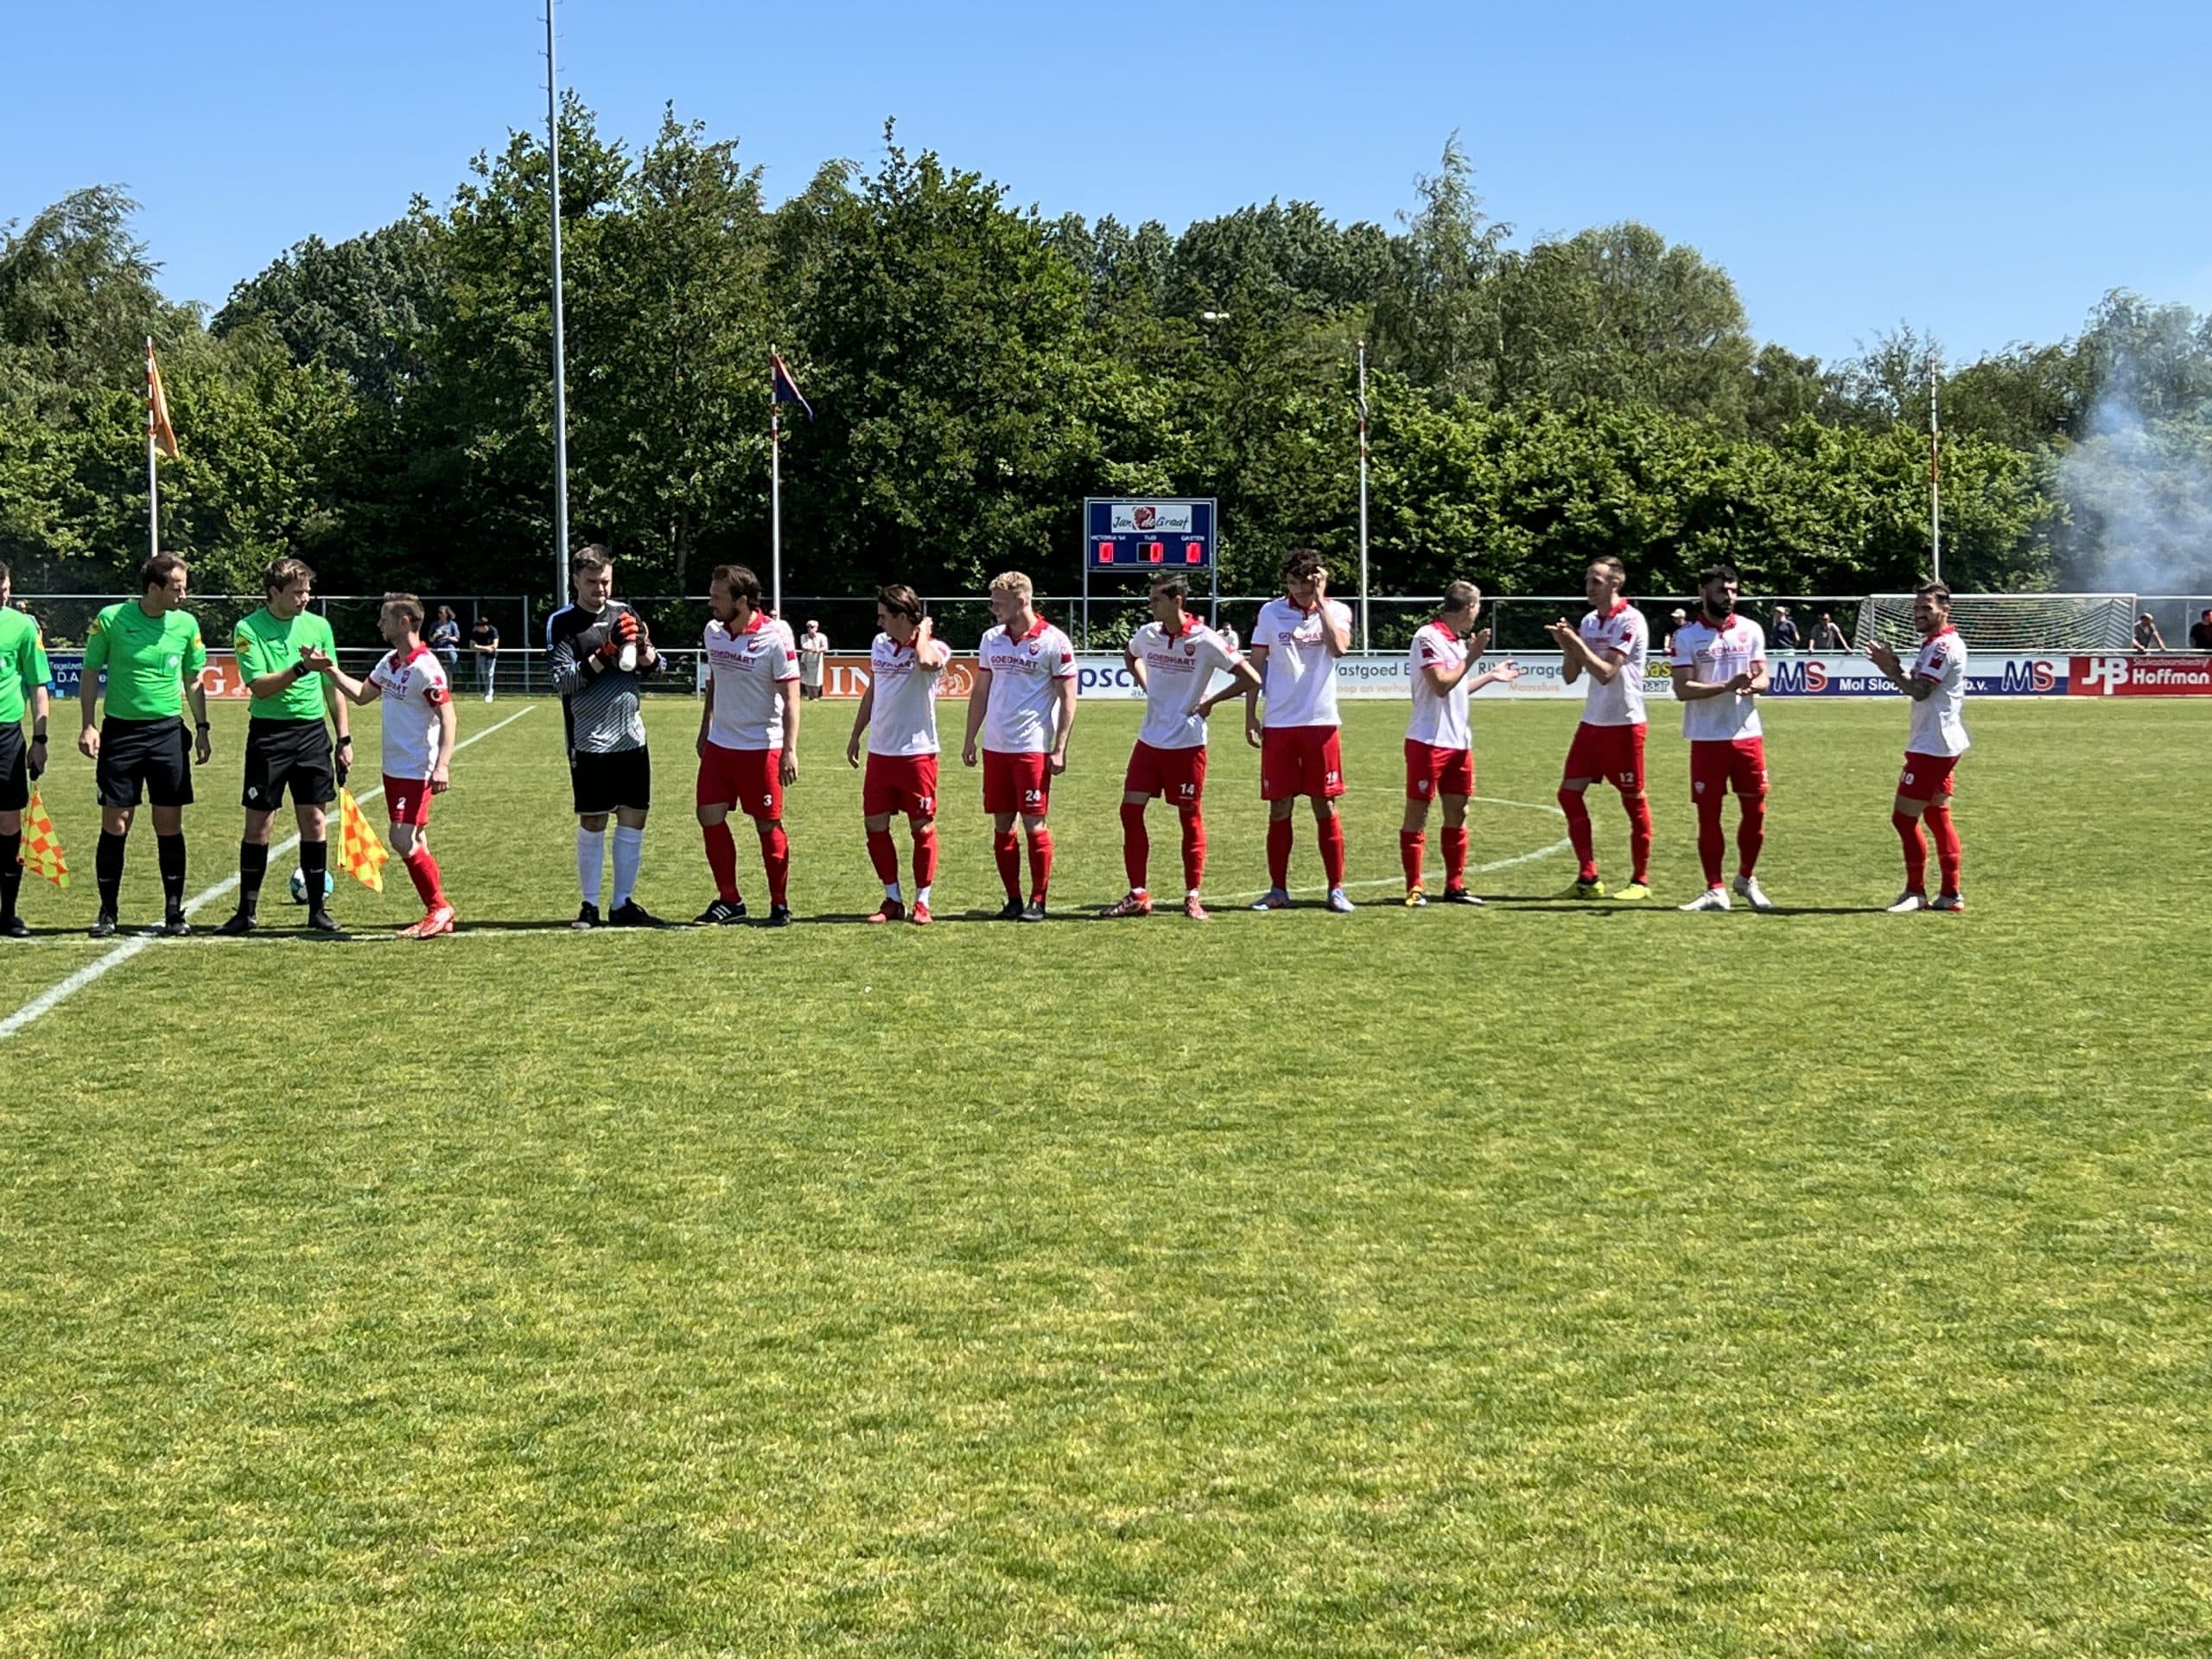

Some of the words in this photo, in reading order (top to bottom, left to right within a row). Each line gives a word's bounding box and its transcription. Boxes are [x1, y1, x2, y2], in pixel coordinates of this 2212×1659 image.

[1112, 516, 1133, 529] Jan
[1156, 516, 1190, 530] Graaf
[991, 655, 1039, 669] GOEDHART
[1147, 652, 1197, 666] GOEDHART
[1772, 660, 1828, 692] MS
[2001, 659, 2056, 692] MS
[2132, 668, 2210, 685] Hoffman
[1839, 677, 1865, 691] Mol
[1619, 772, 1634, 783] 12
[1179, 783, 1195, 794] 14
[763, 794, 772, 806] 3
[1026, 790, 1041, 802] 24
[397, 797, 406, 810] 2
